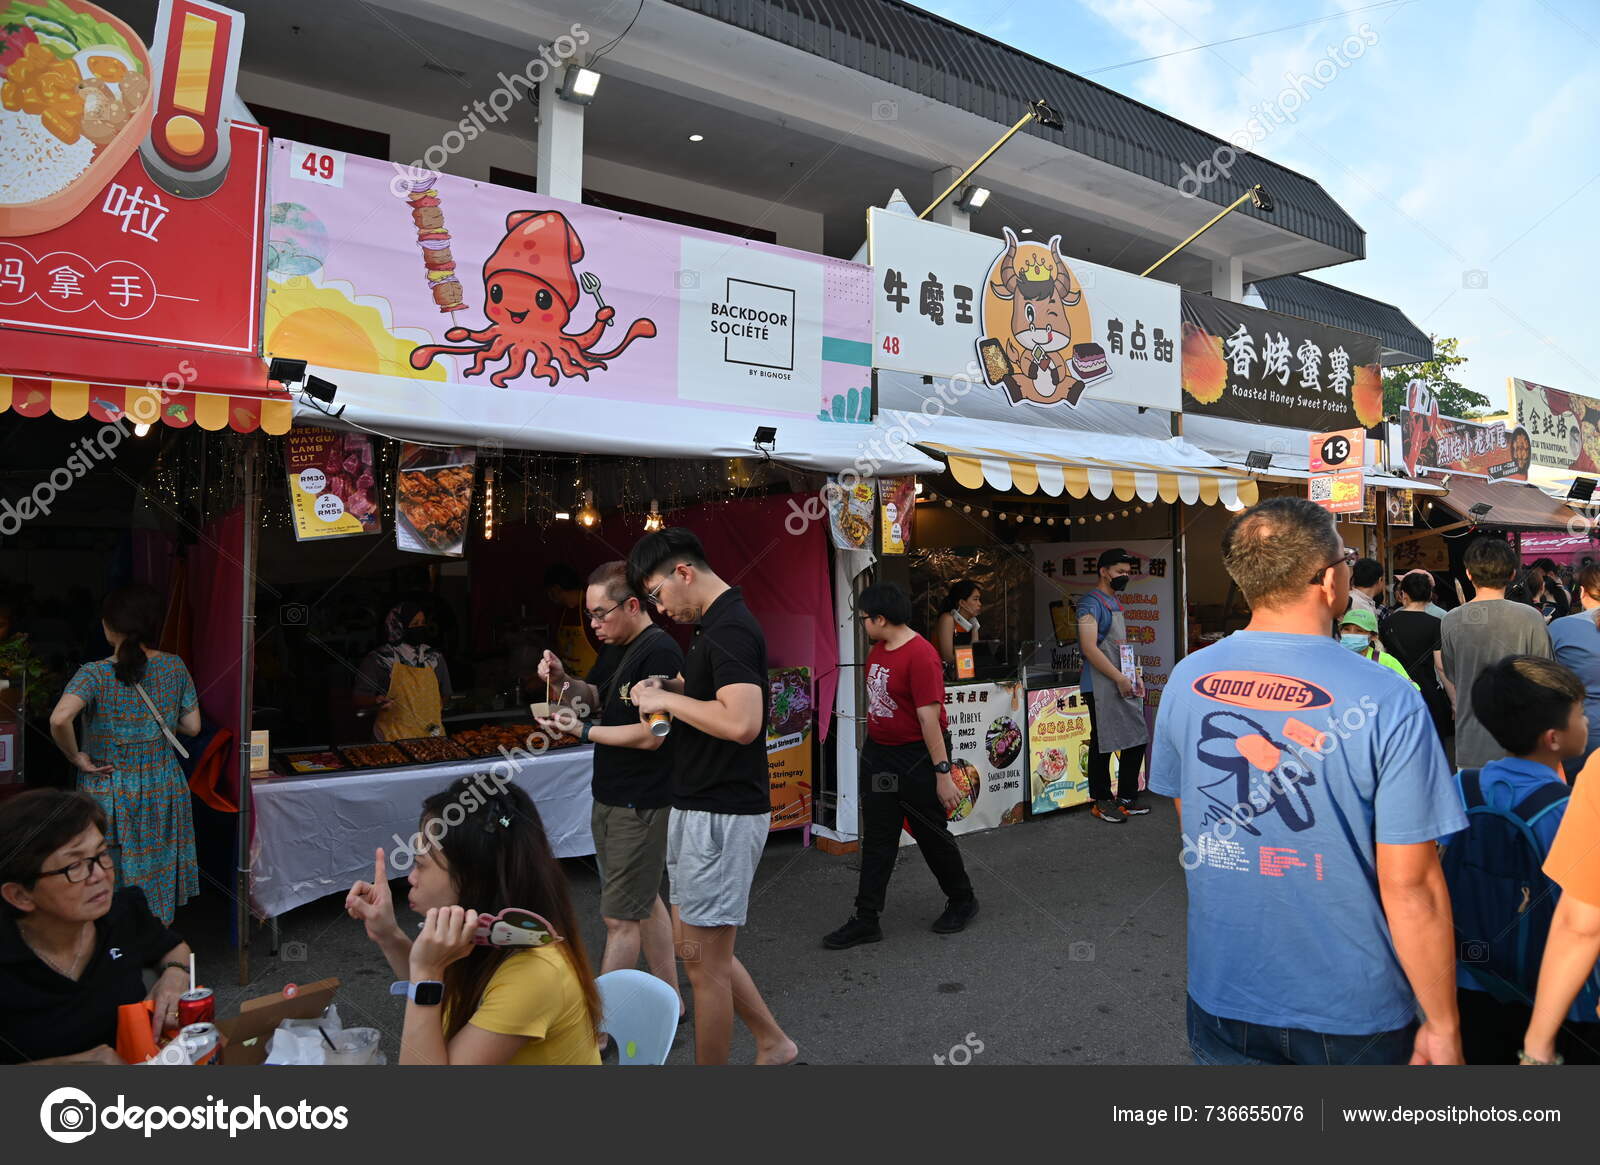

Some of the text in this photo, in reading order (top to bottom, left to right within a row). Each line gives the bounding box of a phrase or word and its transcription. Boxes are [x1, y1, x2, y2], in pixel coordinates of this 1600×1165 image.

[301, 154, 334, 180] 49
[103, 182, 170, 243] 啦
[883, 268, 974, 326] 牛魔王
[711, 302, 788, 327] BACKDOOR
[710, 320, 769, 341] SOCIÉTÉ
[1106, 317, 1175, 363] 有点甜
[882, 335, 900, 356] 48
[1224, 323, 1352, 397] 香烤蜜薯
[760, 370, 792, 381] BIGNOSE
[1231, 384, 1348, 414] Roasted Honey Sweet Potato
[291, 444, 324, 454] LAMB
[291, 454, 315, 462] CUT
[1324, 440, 1348, 460] 13
[1207, 678, 1310, 703] good vibes
[958, 728, 976, 738] RM22
[960, 741, 977, 751] RM39
